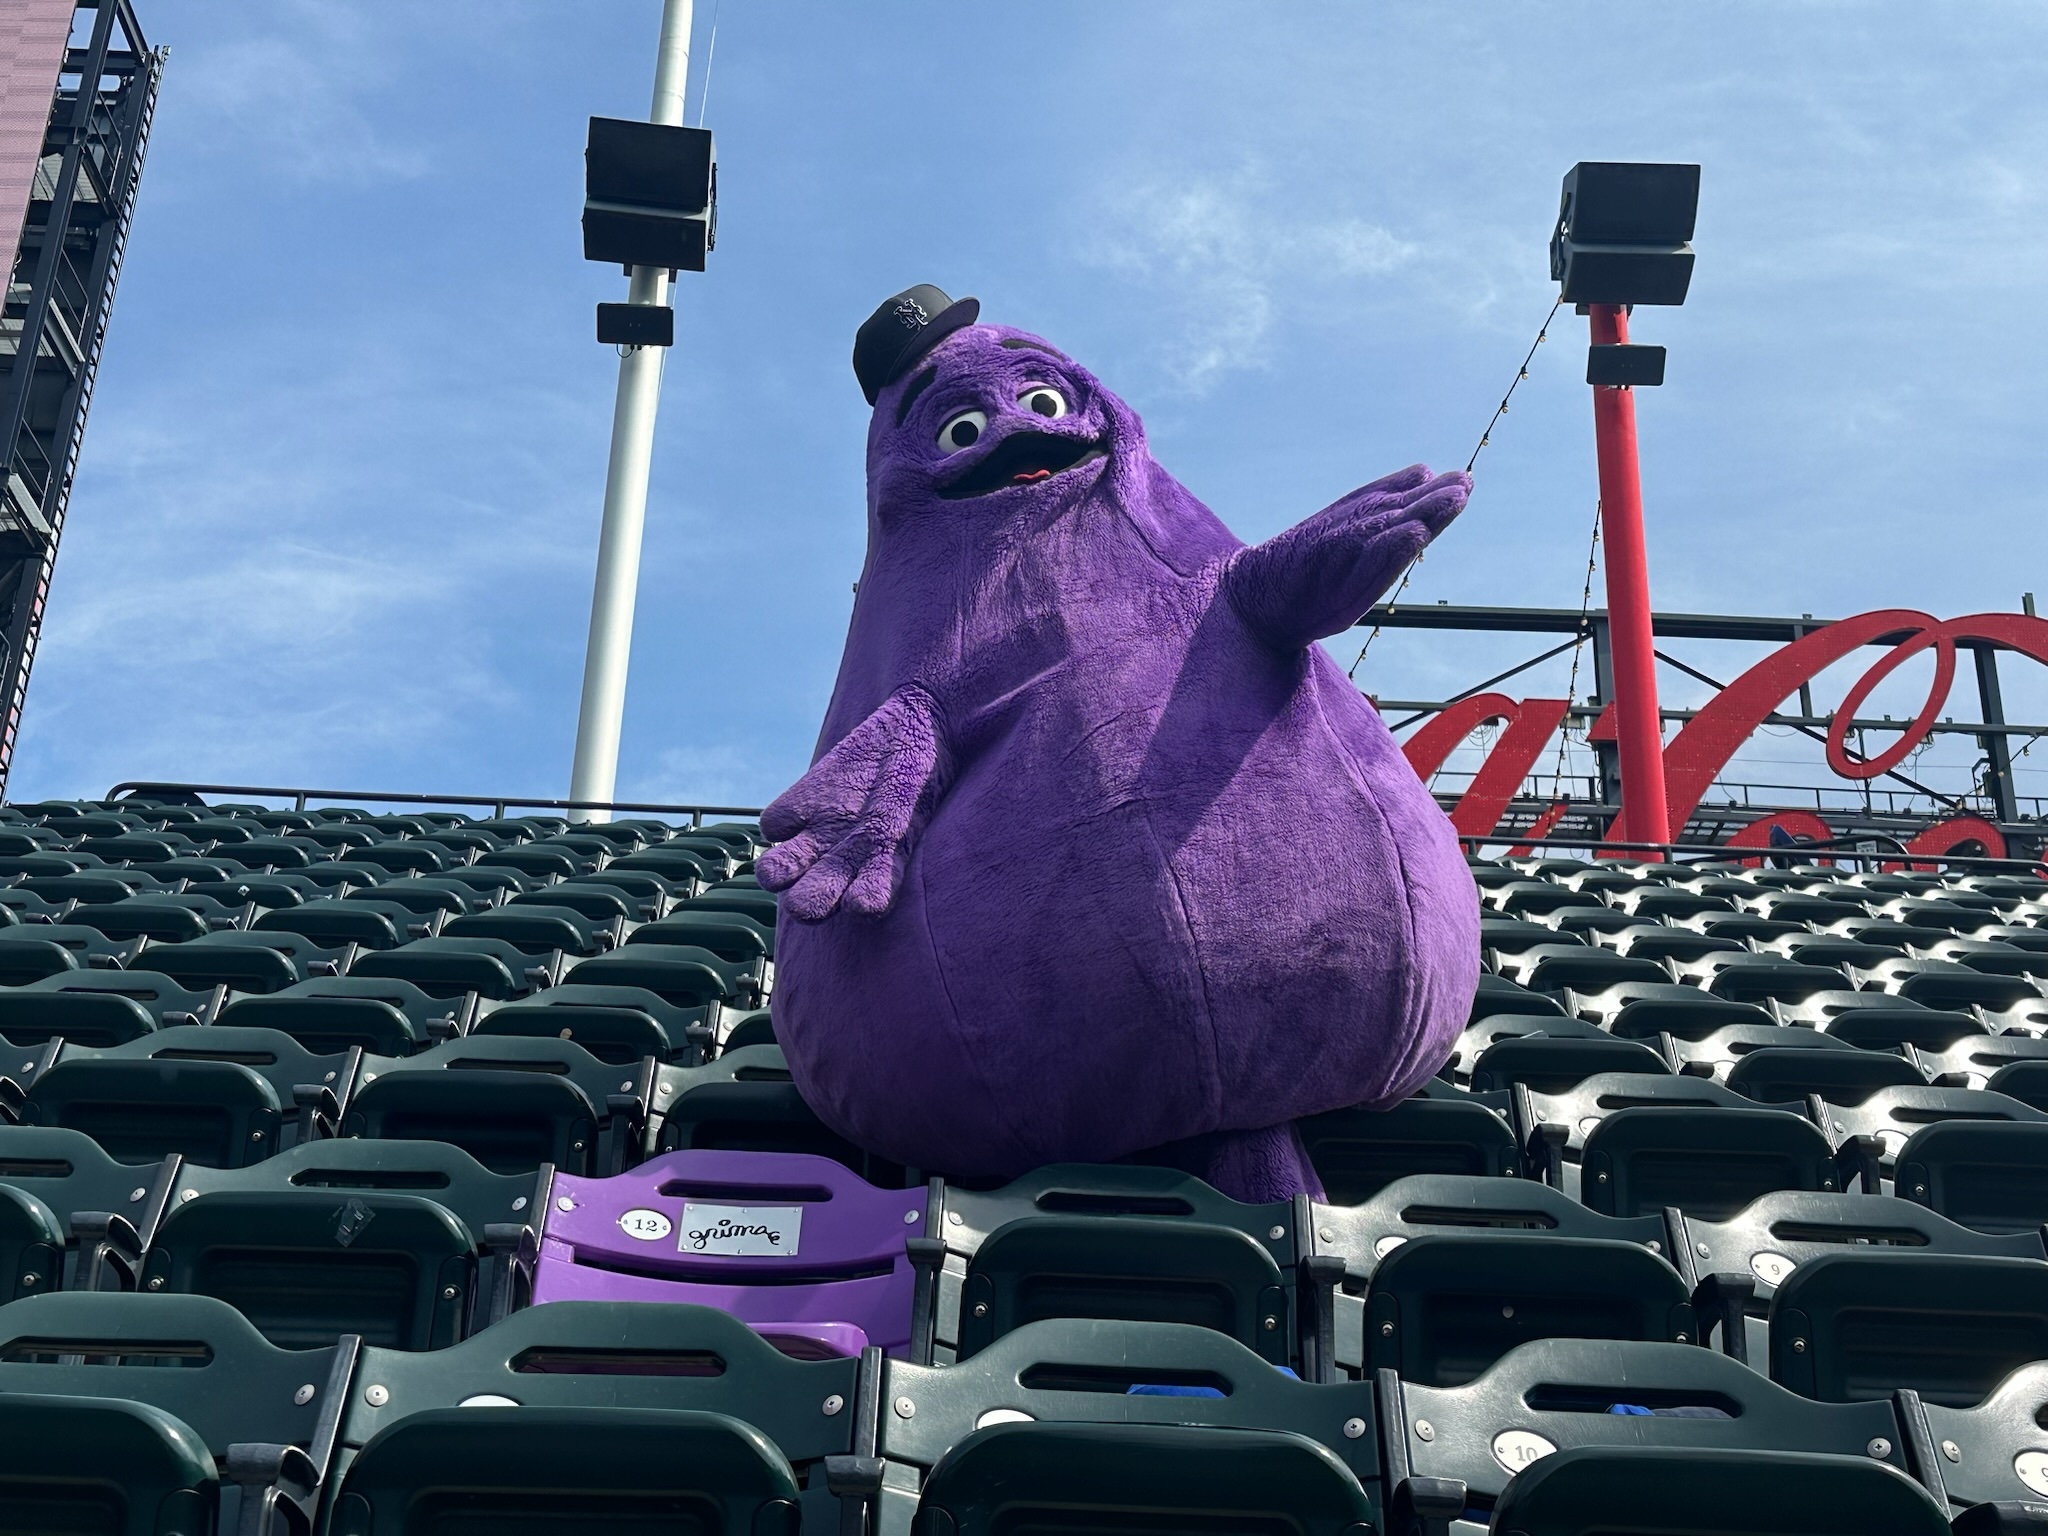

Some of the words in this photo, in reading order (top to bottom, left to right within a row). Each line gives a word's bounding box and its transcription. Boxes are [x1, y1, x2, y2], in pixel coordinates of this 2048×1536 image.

[634, 1218, 657, 1232] 12
[1771, 1264, 1780, 1275] 9
[1515, 1445, 1538, 1462] 10
